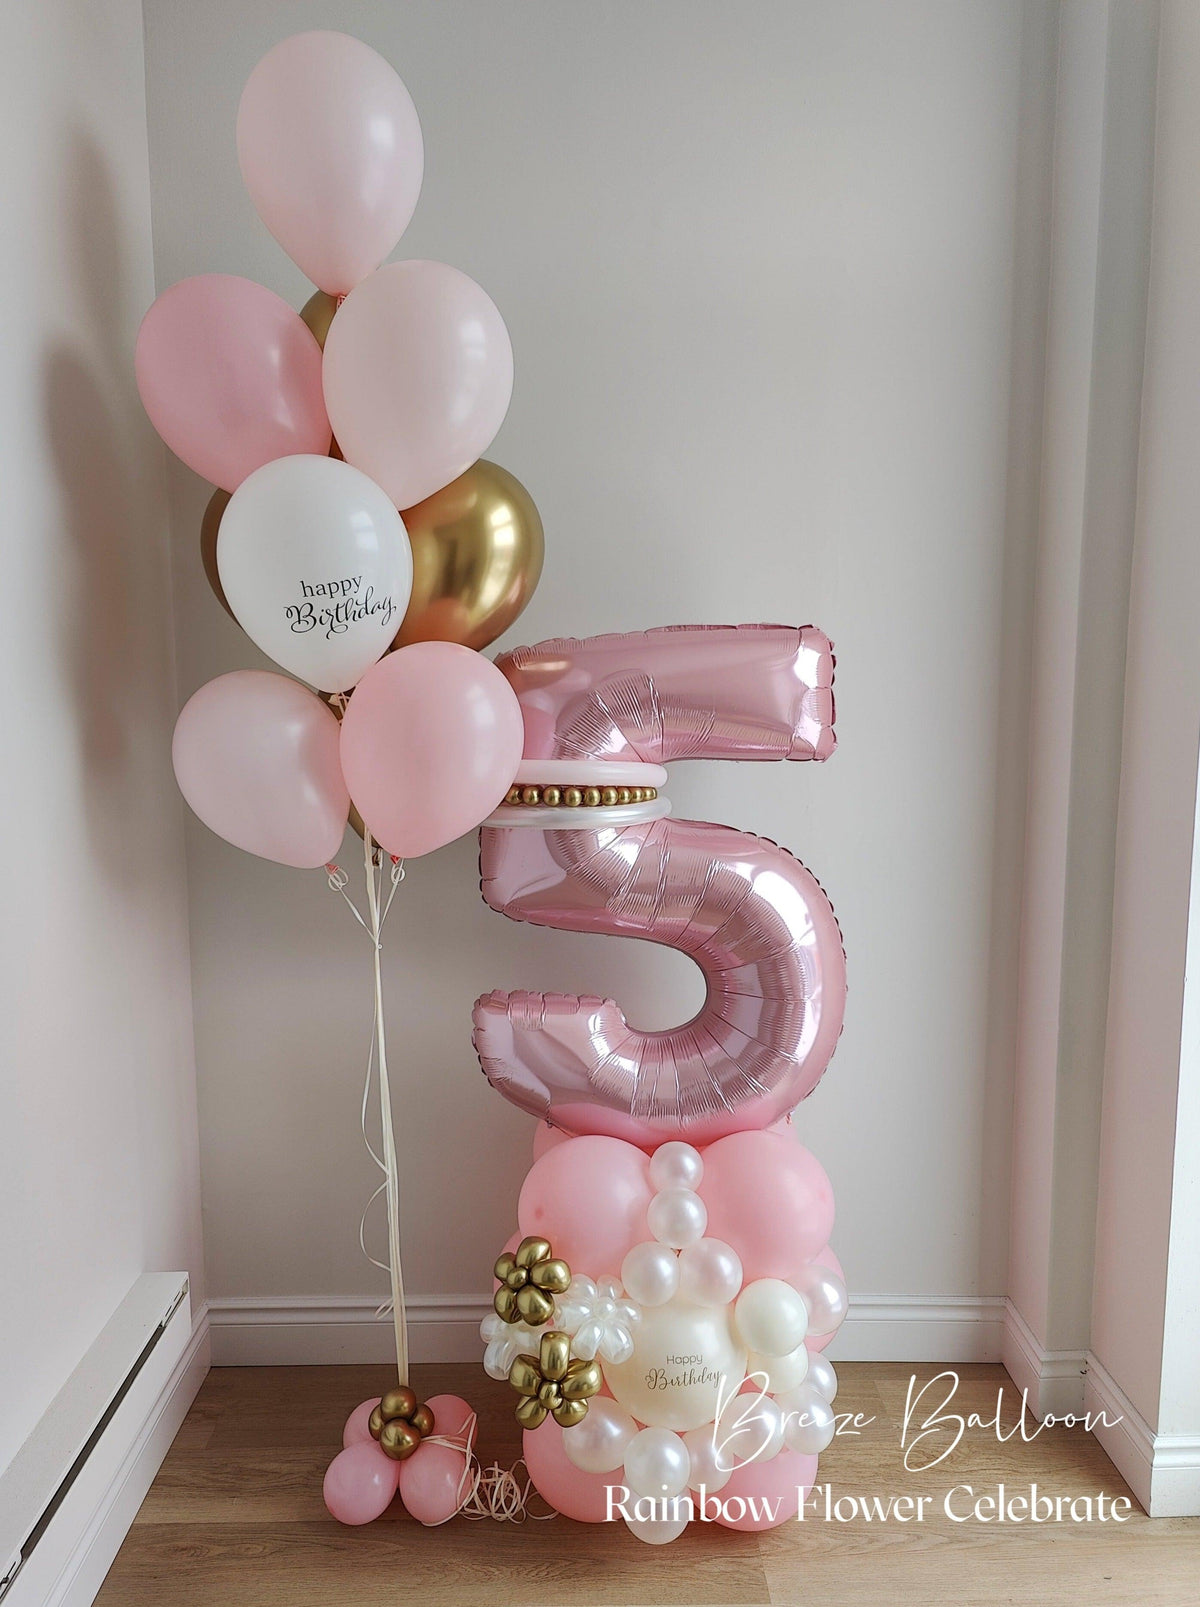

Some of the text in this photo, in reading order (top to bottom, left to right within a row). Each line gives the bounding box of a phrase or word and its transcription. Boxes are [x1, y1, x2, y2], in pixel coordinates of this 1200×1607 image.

[299, 575, 363, 599] happy
[283, 585, 397, 640] Birthday
[666, 1354, 703, 1366] Happy
[644, 1366, 721, 1391] Birthday
